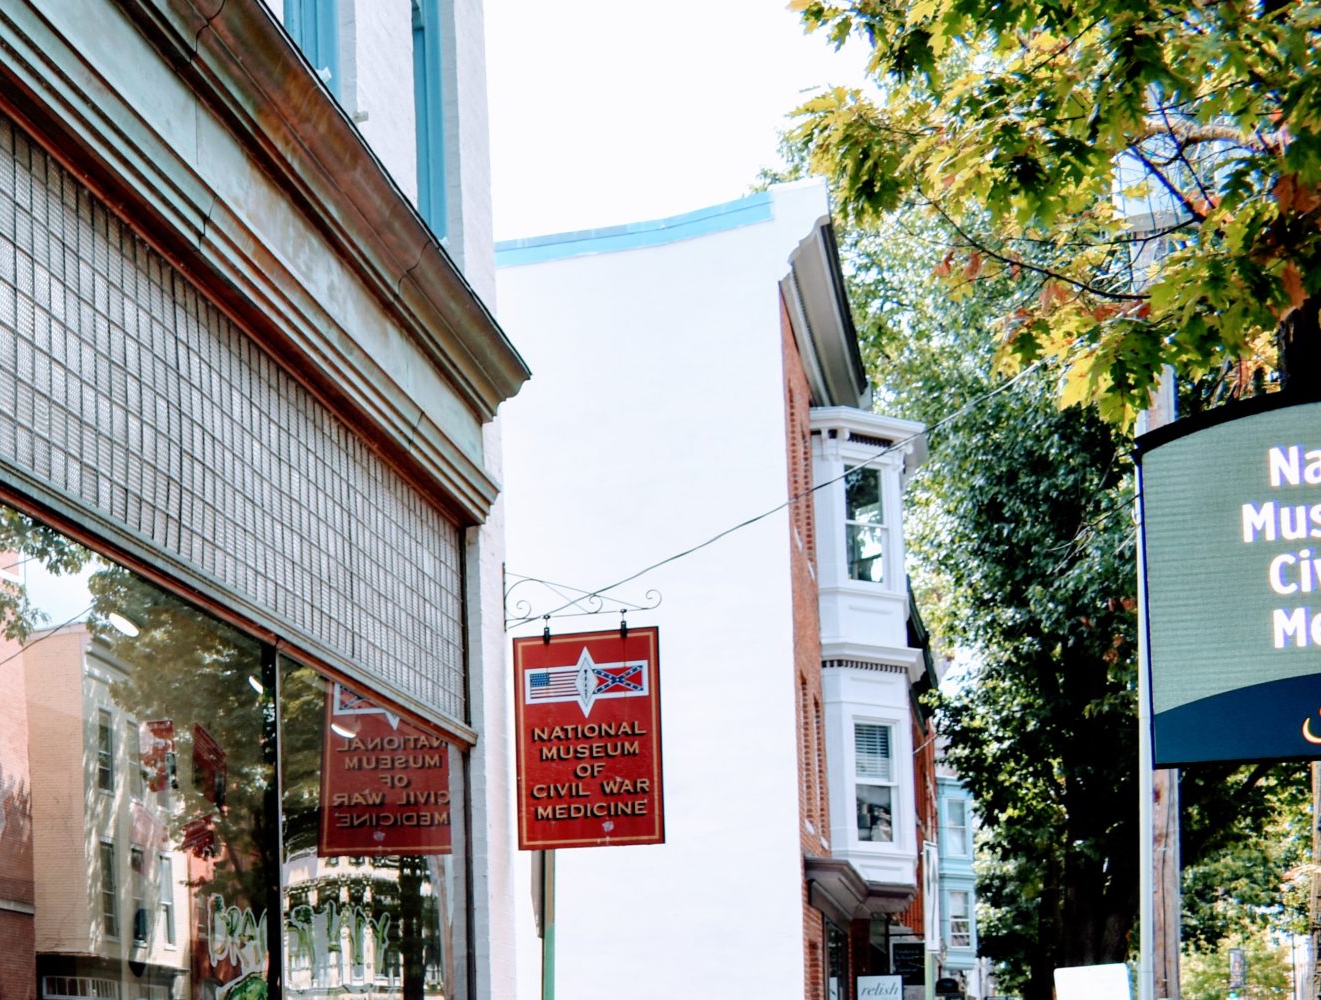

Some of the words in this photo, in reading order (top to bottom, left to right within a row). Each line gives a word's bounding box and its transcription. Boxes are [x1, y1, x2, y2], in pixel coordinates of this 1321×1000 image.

[1269, 549, 1321, 594] Ci
[534, 721, 647, 741] NATIONAL
[542, 741, 640, 761] MUSEUM
[575, 763, 606, 778] OF
[532, 783, 591, 799] CIVIL
[601, 778, 650, 796] WAR
[536, 801, 648, 821] MEDICINE
[860, 982, 899, 997] relish
